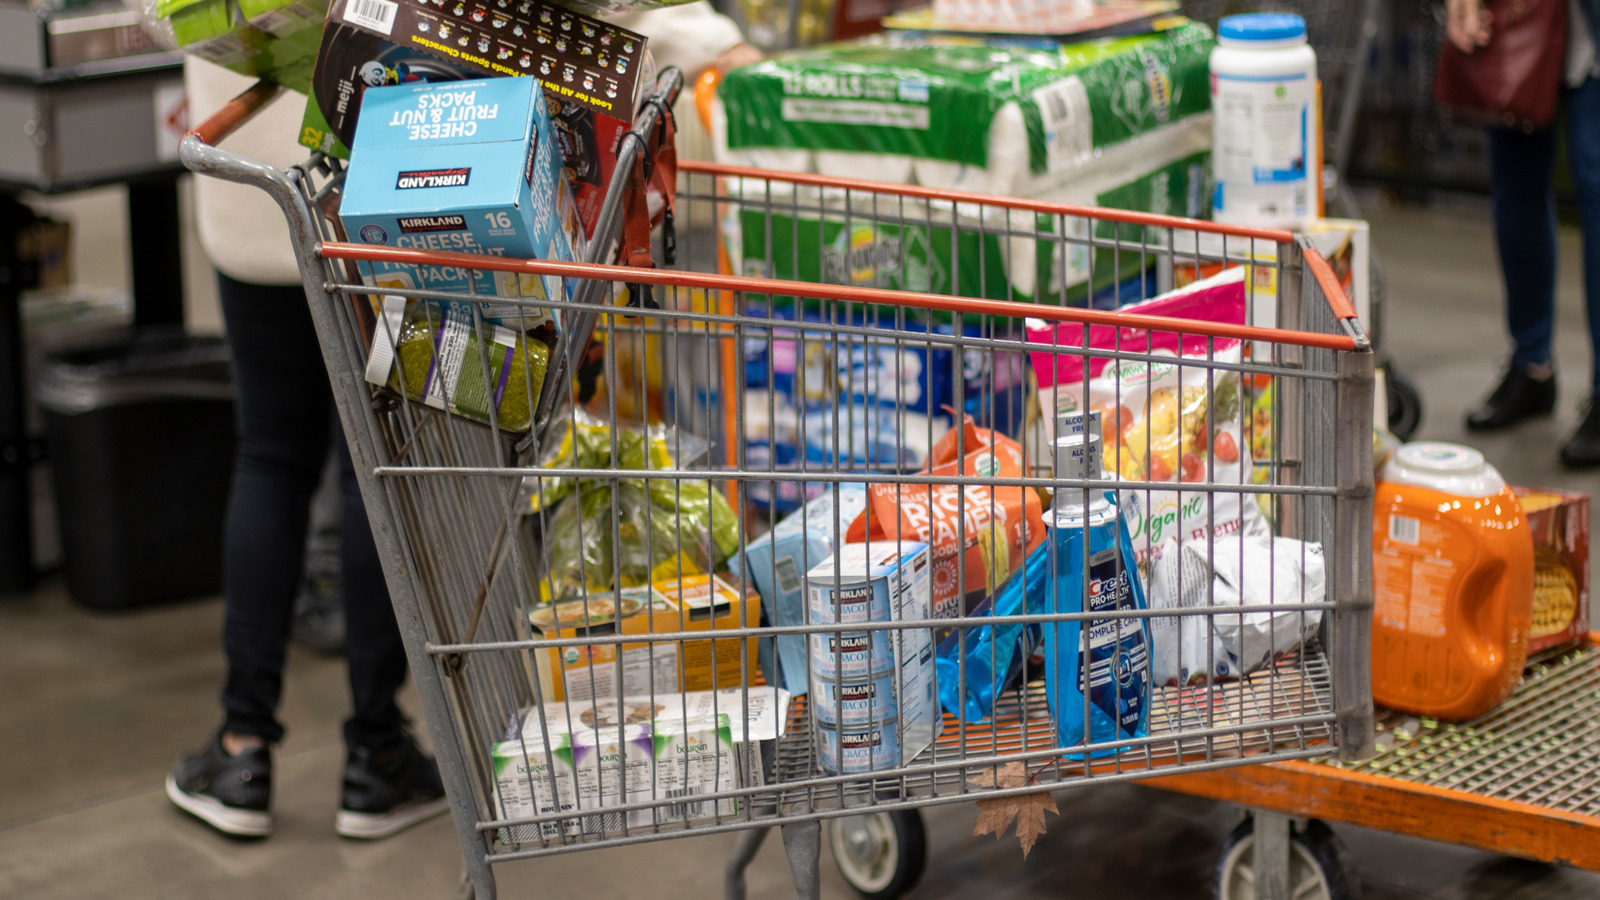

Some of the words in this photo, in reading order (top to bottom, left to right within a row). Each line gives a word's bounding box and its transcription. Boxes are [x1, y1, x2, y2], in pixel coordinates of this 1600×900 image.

[412, 35, 459, 58] Characters
[461, 52, 490, 68] Sports
[491, 62, 519, 78] Panda
[545, 81, 560, 92] the
[561, 87, 574, 97] All
[804, 73, 862, 98] ROLLS
[337, 78, 353, 115] meiji
[418, 90, 476, 109] PACKS
[575, 92, 588, 102] for
[590, 96, 612, 111] Look
[389, 109, 427, 126] NUT
[430, 108, 443, 123] &
[447, 103, 498, 122] FRUIT
[301, 126, 323, 150] 32
[406, 121, 478, 140] CHEESE,
[526, 123, 537, 181] KIRKLAND
[398, 174, 466, 188] KIRKLAND
[401, 216, 464, 228] KIRKLAND
[484, 211, 512, 229] 16
[396, 232, 482, 250] CHEESE,
[415, 266, 484, 283] PACKS
[1065, 414, 1096, 427] ALCOOL
[1071, 445, 1096, 458] ALCOL
[1080, 455, 1093, 465] FE
[901, 485, 991, 528] RICE
[916, 502, 1008, 547] RAMEN
[932, 537, 973, 558] OODLS
[1089, 570, 1128, 597] Cret
[831, 588, 873, 601] RKLAN
[829, 601, 876, 615] ABACOE
[934, 595, 961, 612] OTUS
[1082, 621, 1123, 640] OMPLETE
[831, 637, 872, 649] KRKLAN
[829, 651, 876, 663] ABACOE
[834, 684, 875, 697] RKLAN
[832, 699, 877, 712] ABACOE
[841, 732, 881, 746] KIRKLAD
[676, 742, 708, 755] boursin
[841, 747, 883, 759] LBACORE
[600, 752, 628, 763] oursn
[541, 804, 573, 813] BOUSIN
